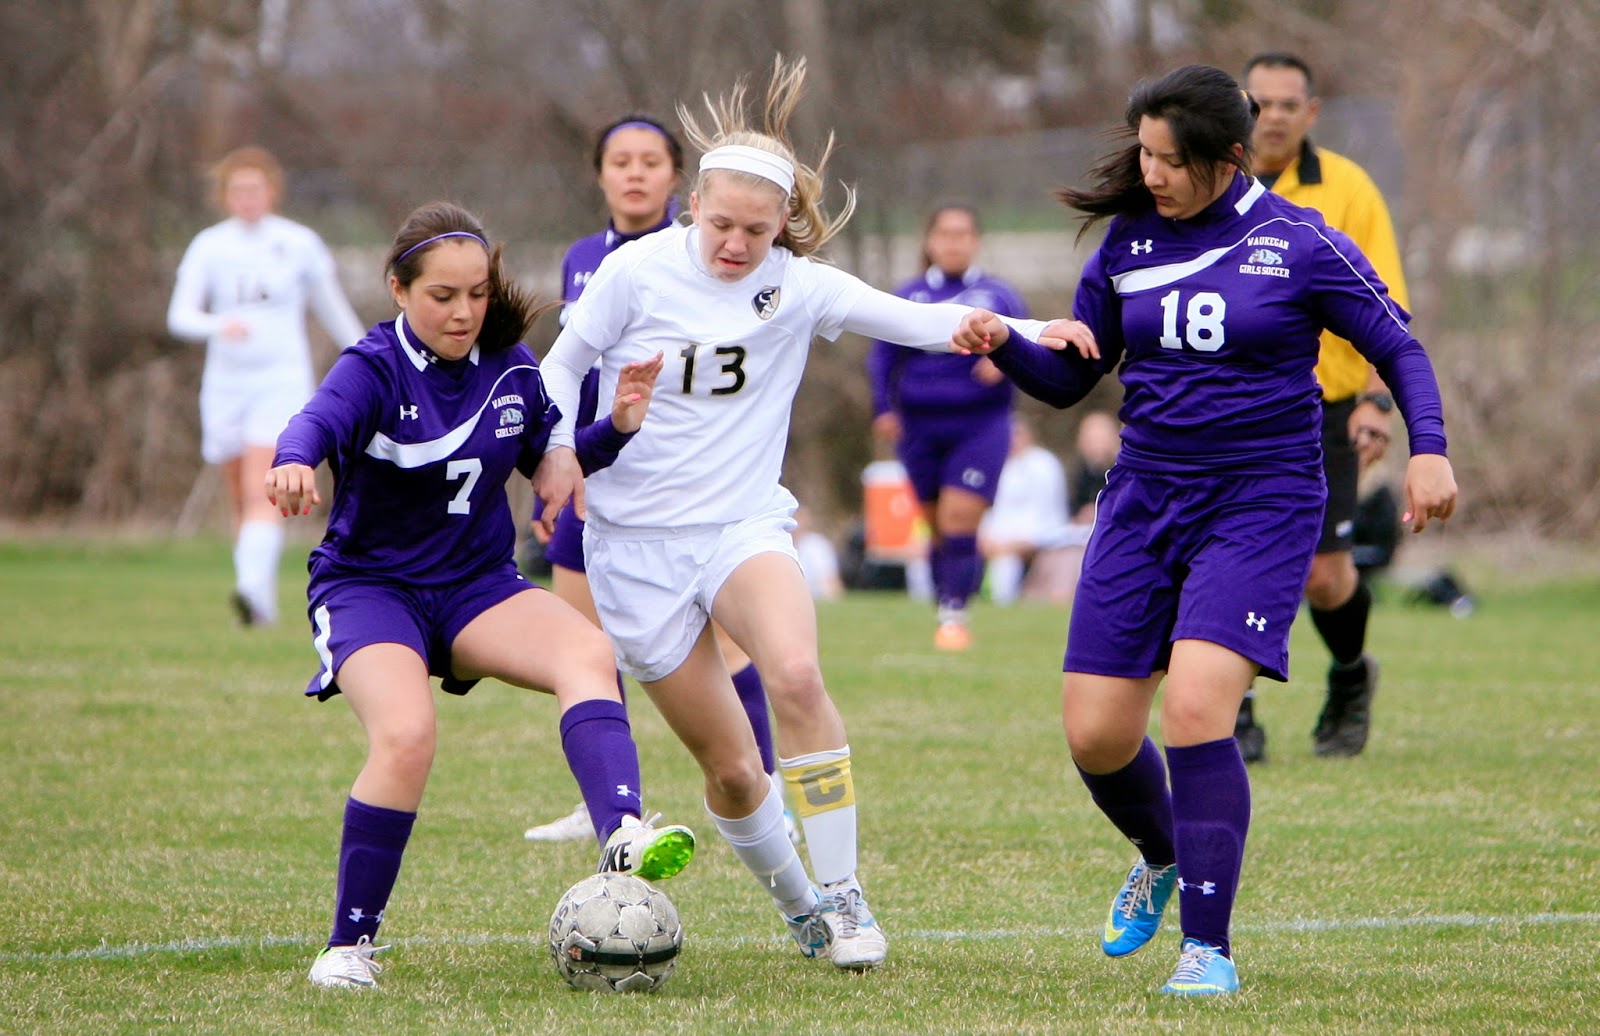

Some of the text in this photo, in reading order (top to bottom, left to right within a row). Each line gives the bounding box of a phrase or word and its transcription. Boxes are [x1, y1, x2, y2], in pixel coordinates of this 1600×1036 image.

[1247, 236, 1290, 250] WAUKEGAN
[1239, 264, 1290, 278] GIRLS SOCCER
[1159, 290, 1227, 352] 18
[679, 342, 747, 397] 13
[446, 457, 483, 515] 7
[798, 766, 846, 807] C
